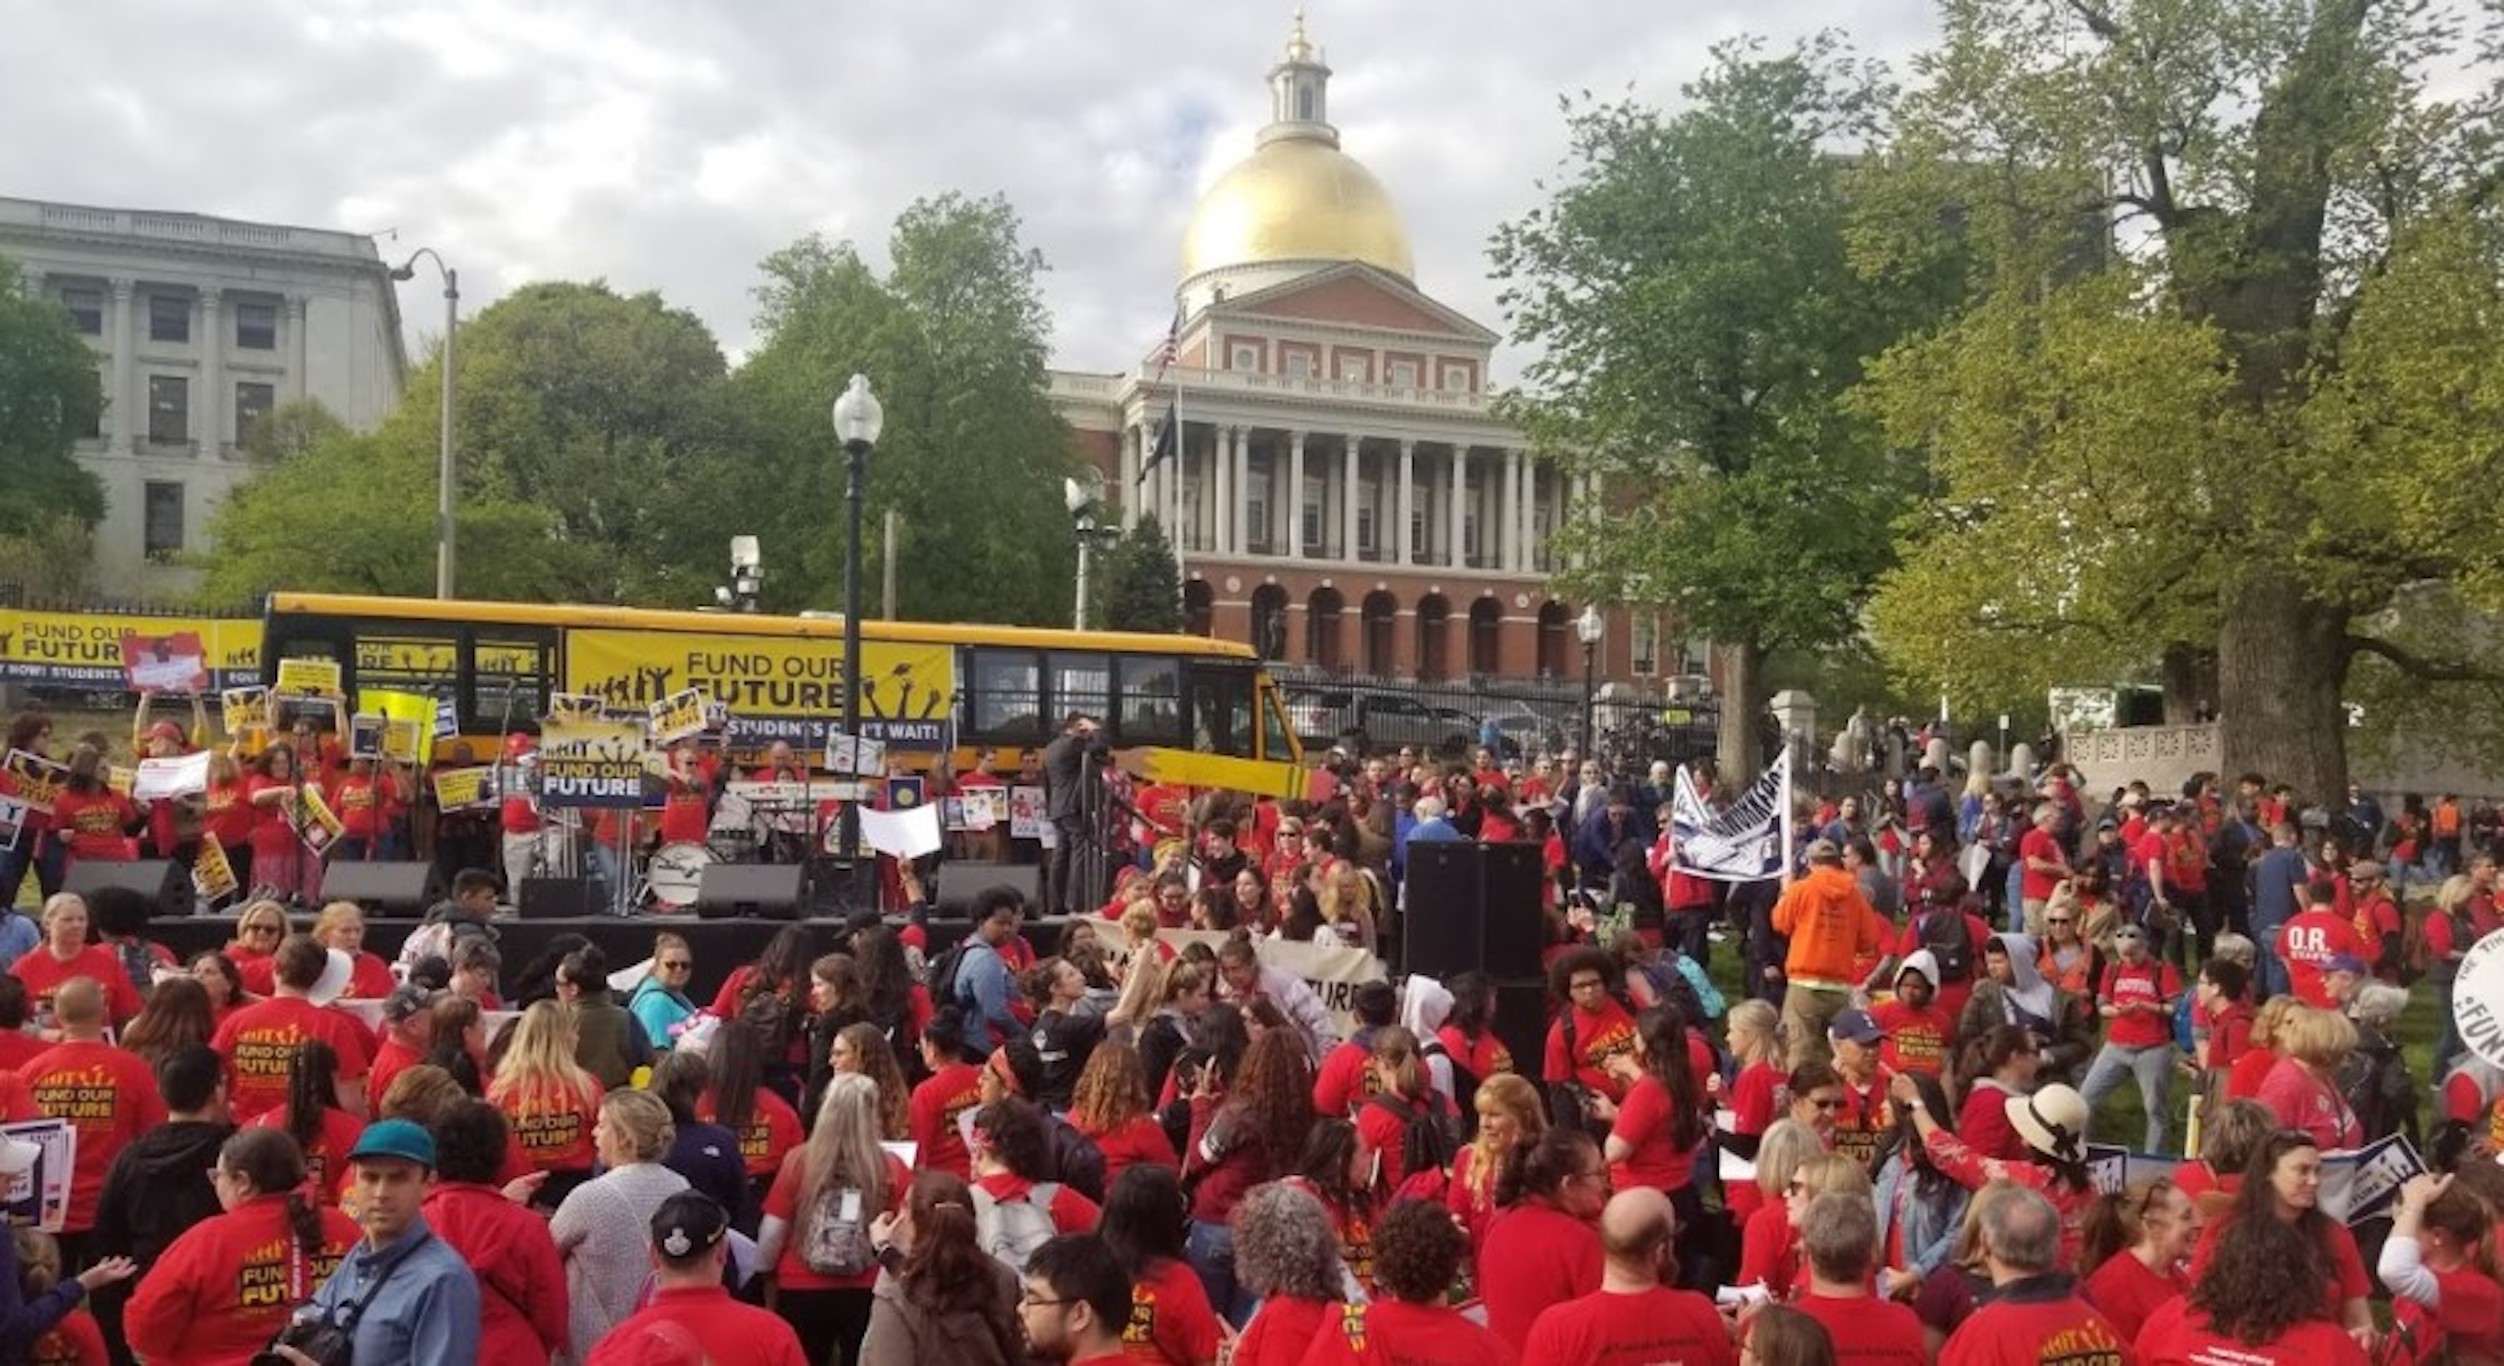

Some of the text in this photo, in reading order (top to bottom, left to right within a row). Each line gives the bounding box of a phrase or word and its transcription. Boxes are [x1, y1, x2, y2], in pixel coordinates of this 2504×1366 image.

[22, 622, 84, 640] FUND
[24, 640, 119, 661] FUTUR
[51, 667, 122, 680] STUDENTS
[688, 652, 846, 678] FUND OUR
[688, 678, 845, 707] FUTURE
[728, 720, 824, 737] STUDENS
[888, 724, 938, 740] WAIT!
[544, 763, 641, 778] FUND OUR
[543, 778, 641, 796] FUTURE
[78, 1088, 113, 1101] OUR
[242, 1264, 285, 1285] FUN
